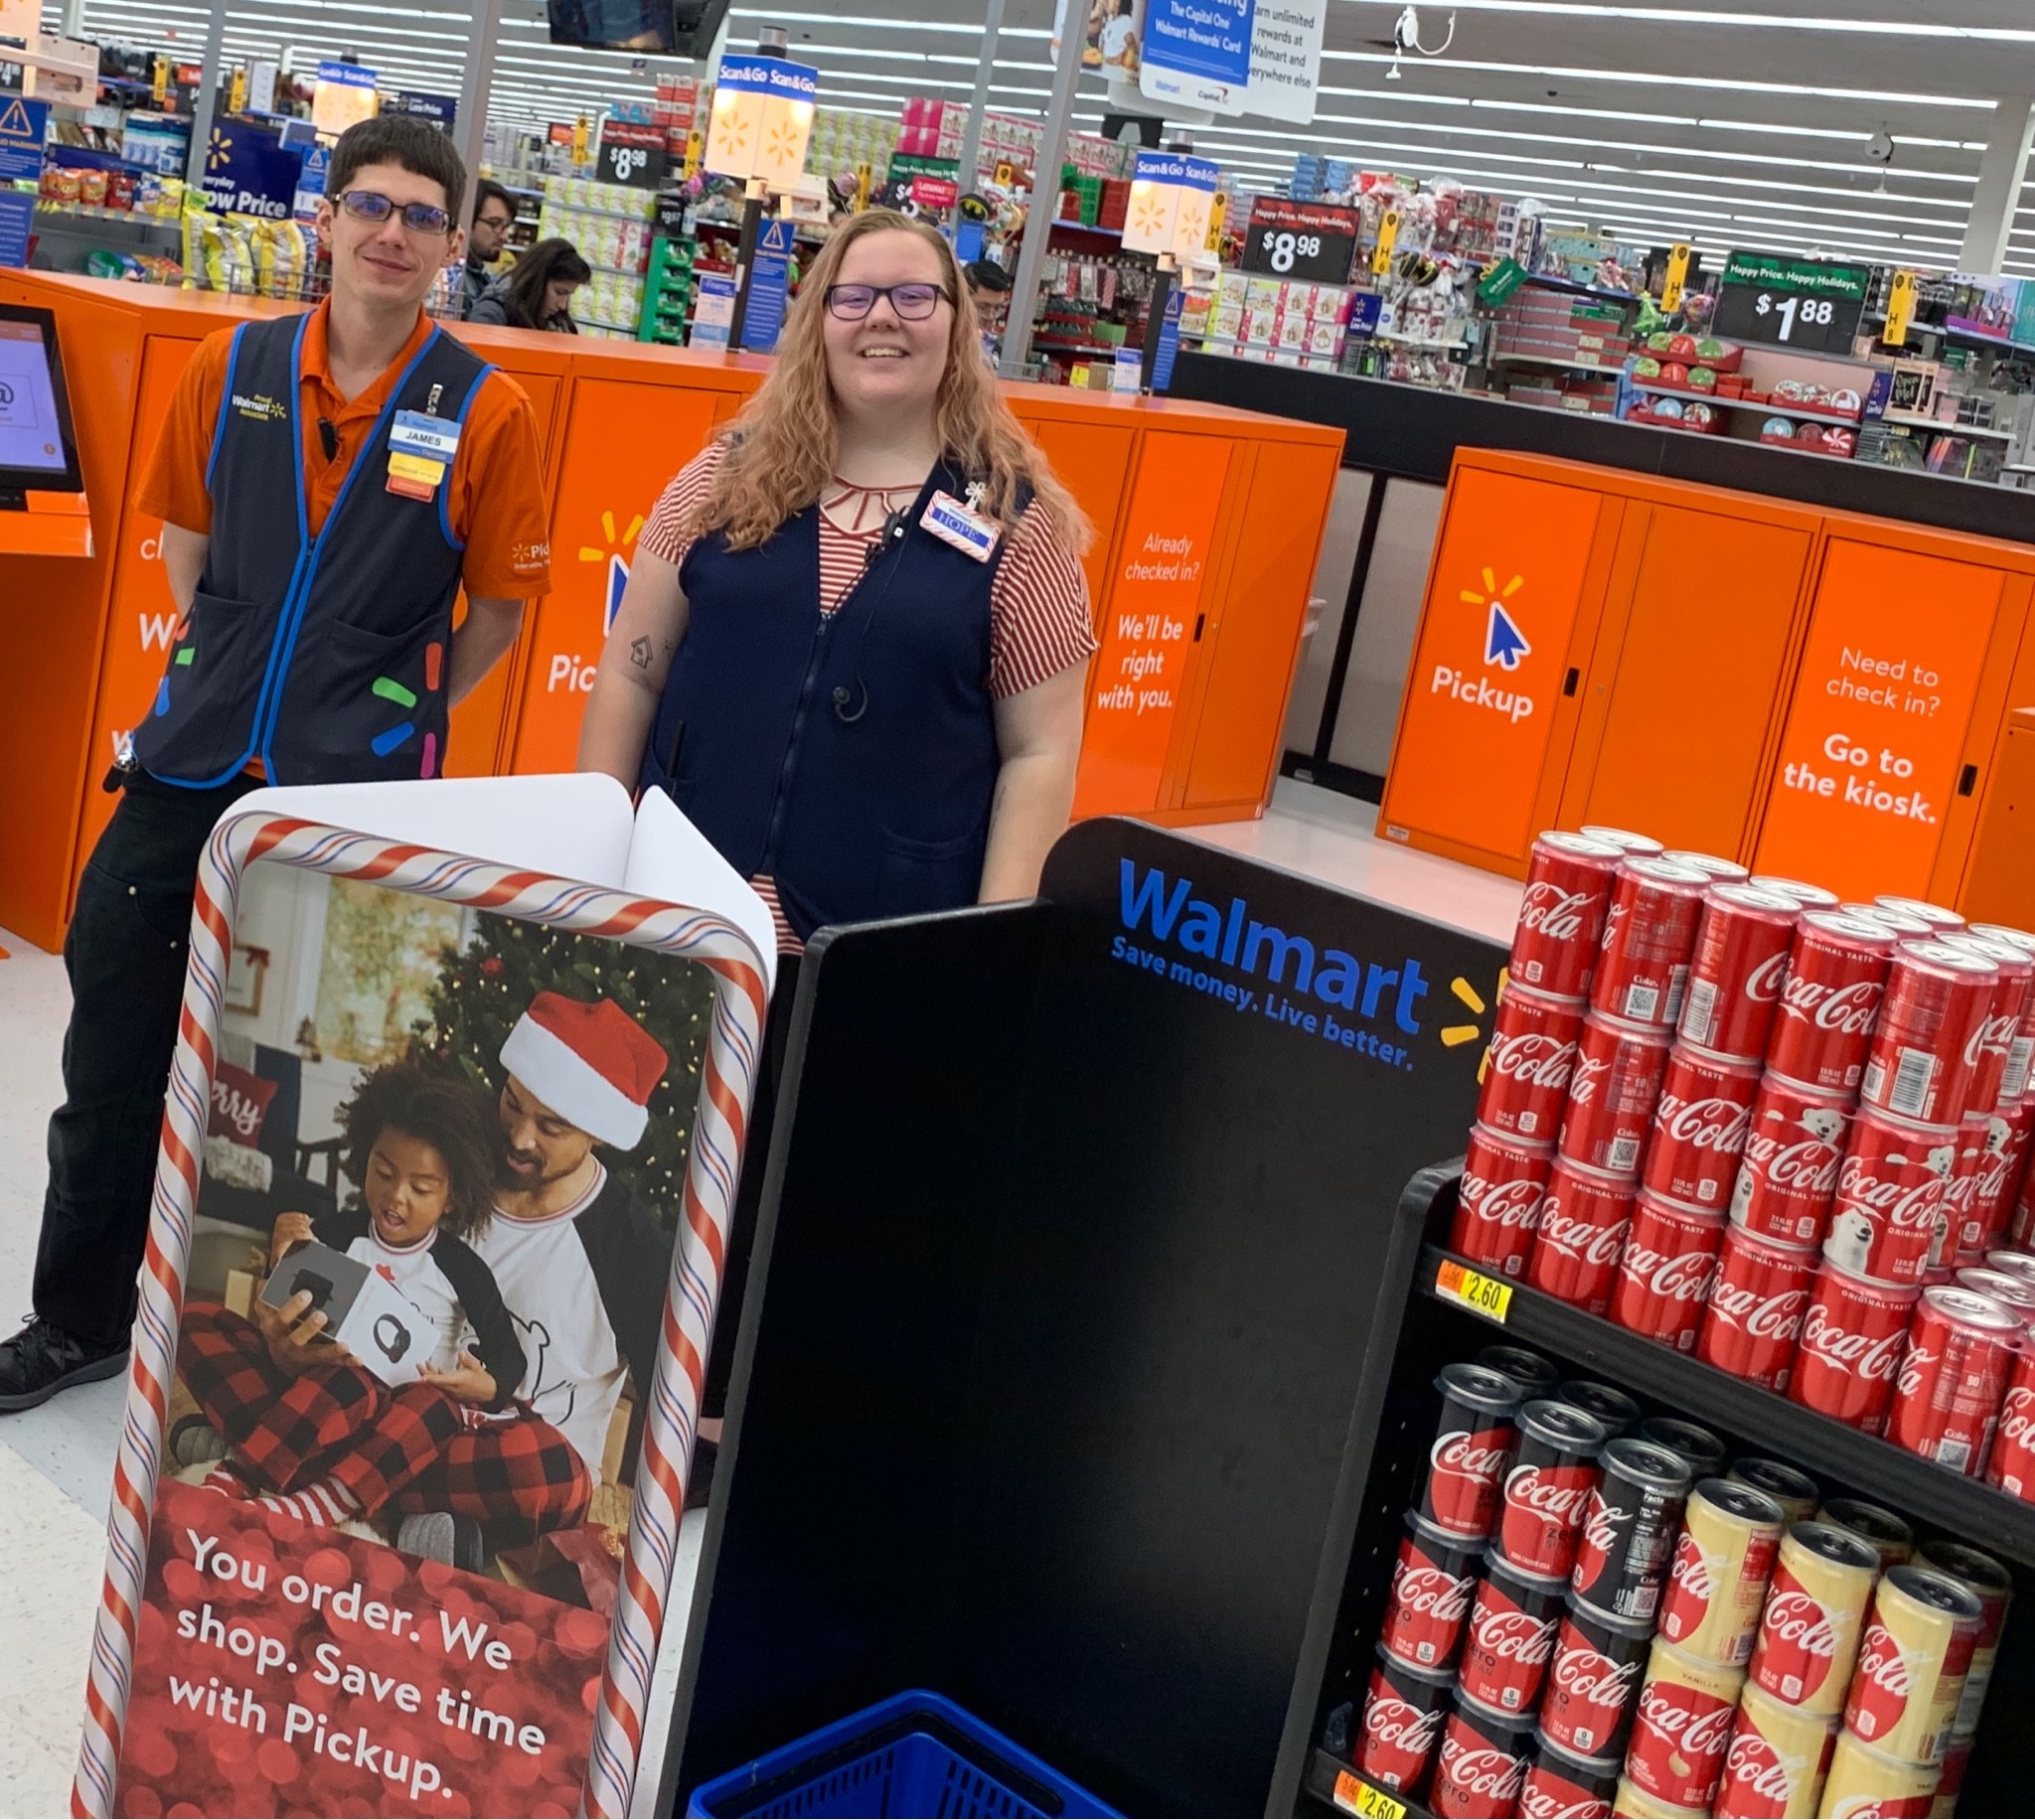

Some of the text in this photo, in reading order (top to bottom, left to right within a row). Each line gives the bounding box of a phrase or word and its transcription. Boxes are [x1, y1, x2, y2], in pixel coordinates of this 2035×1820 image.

[1171, 1, 1185, 18] The
[1185, 3, 1212, 25] Capital
[1213, 14, 1230, 29] One
[1272, 9, 1315, 29] unlimited
[1156, 18, 1241, 54] Walmart Rewards Card
[1257, 27, 1304, 47] rewards at
[1251, 43, 1287, 64] Walmart
[1289, 53, 1306, 68] and
[719, 65, 815, 92] Scan&Go Scan&Go
[1249, 66, 1312, 88] verywhere else
[204, 176, 235, 190] veryday
[1137, 161, 1217, 182] Scan&Go Scan&Go
[207, 191, 287, 218] ow Price
[1255, 209, 1277, 220] Happy
[1298, 214, 1320, 225] Happy
[1380, 246, 1389, 257] H
[1670, 282, 1680, 294] H
[1730, 264, 1858, 290] Happy Price. Happy Holidays.
[1889, 312, 1898, 324] H
[233, 394, 269, 413] Walmart
[405, 431, 441, 447] JAMES
[938, 513, 978, 540] HOPE
[531, 543, 549, 558] Pic
[1143, 532, 1192, 558] Already
[1125, 559, 1200, 581] checked in?
[1118, 614, 1182, 641] We'll be
[548, 654, 596, 692] Pic
[1121, 649, 1165, 682] right
[1840, 646, 1939, 687] Need to
[1098, 683, 1173, 715] with you.
[1431, 665, 1533, 724] Pickup
[1825, 677, 1941, 717] check in?
[1823, 733, 1913, 778] Go to
[1784, 762, 1937, 824] the kiosk.
[1120, 857, 1430, 1035] Walmart
[1803, 939, 1874, 963] ORIGINAL TASTE
[1111, 935, 1413, 1072] Save money. Live better.
[1518, 1003, 1542, 1016] TASTE
[1490, 1031, 1578, 1089] a-Cola
[1697, 1067, 1724, 1081] TASTE
[212, 1082, 263, 1136] rry
[1657, 1090, 1753, 1152] a-Cola
[1504, 1151, 1529, 1163] TASTE
[1571, 1181, 1612, 1199] ORIGINAL
[1764, 1182, 1808, 1200] ORIGINAL
[1642, 1206, 1705, 1235] ORIGINAL TASTE
[1888, 1227, 1927, 1239] ORIGINAL
[1734, 1246, 1802, 1273] ORIGINAL TASTE
[1841, 1289, 1886, 1309] ORIGINAL
[1966, 1375, 1979, 1388] 90
[1644, 1493, 1664, 1504] Facts
[185, 1528, 513, 1670] You order. We
[1472, 1599, 1559, 1665] a-Cola
[177, 1603, 547, 1754] shop. Save time
[1683, 1672, 1718, 1689] VANILLA
[169, 1675, 453, 1800] with Pickup.
